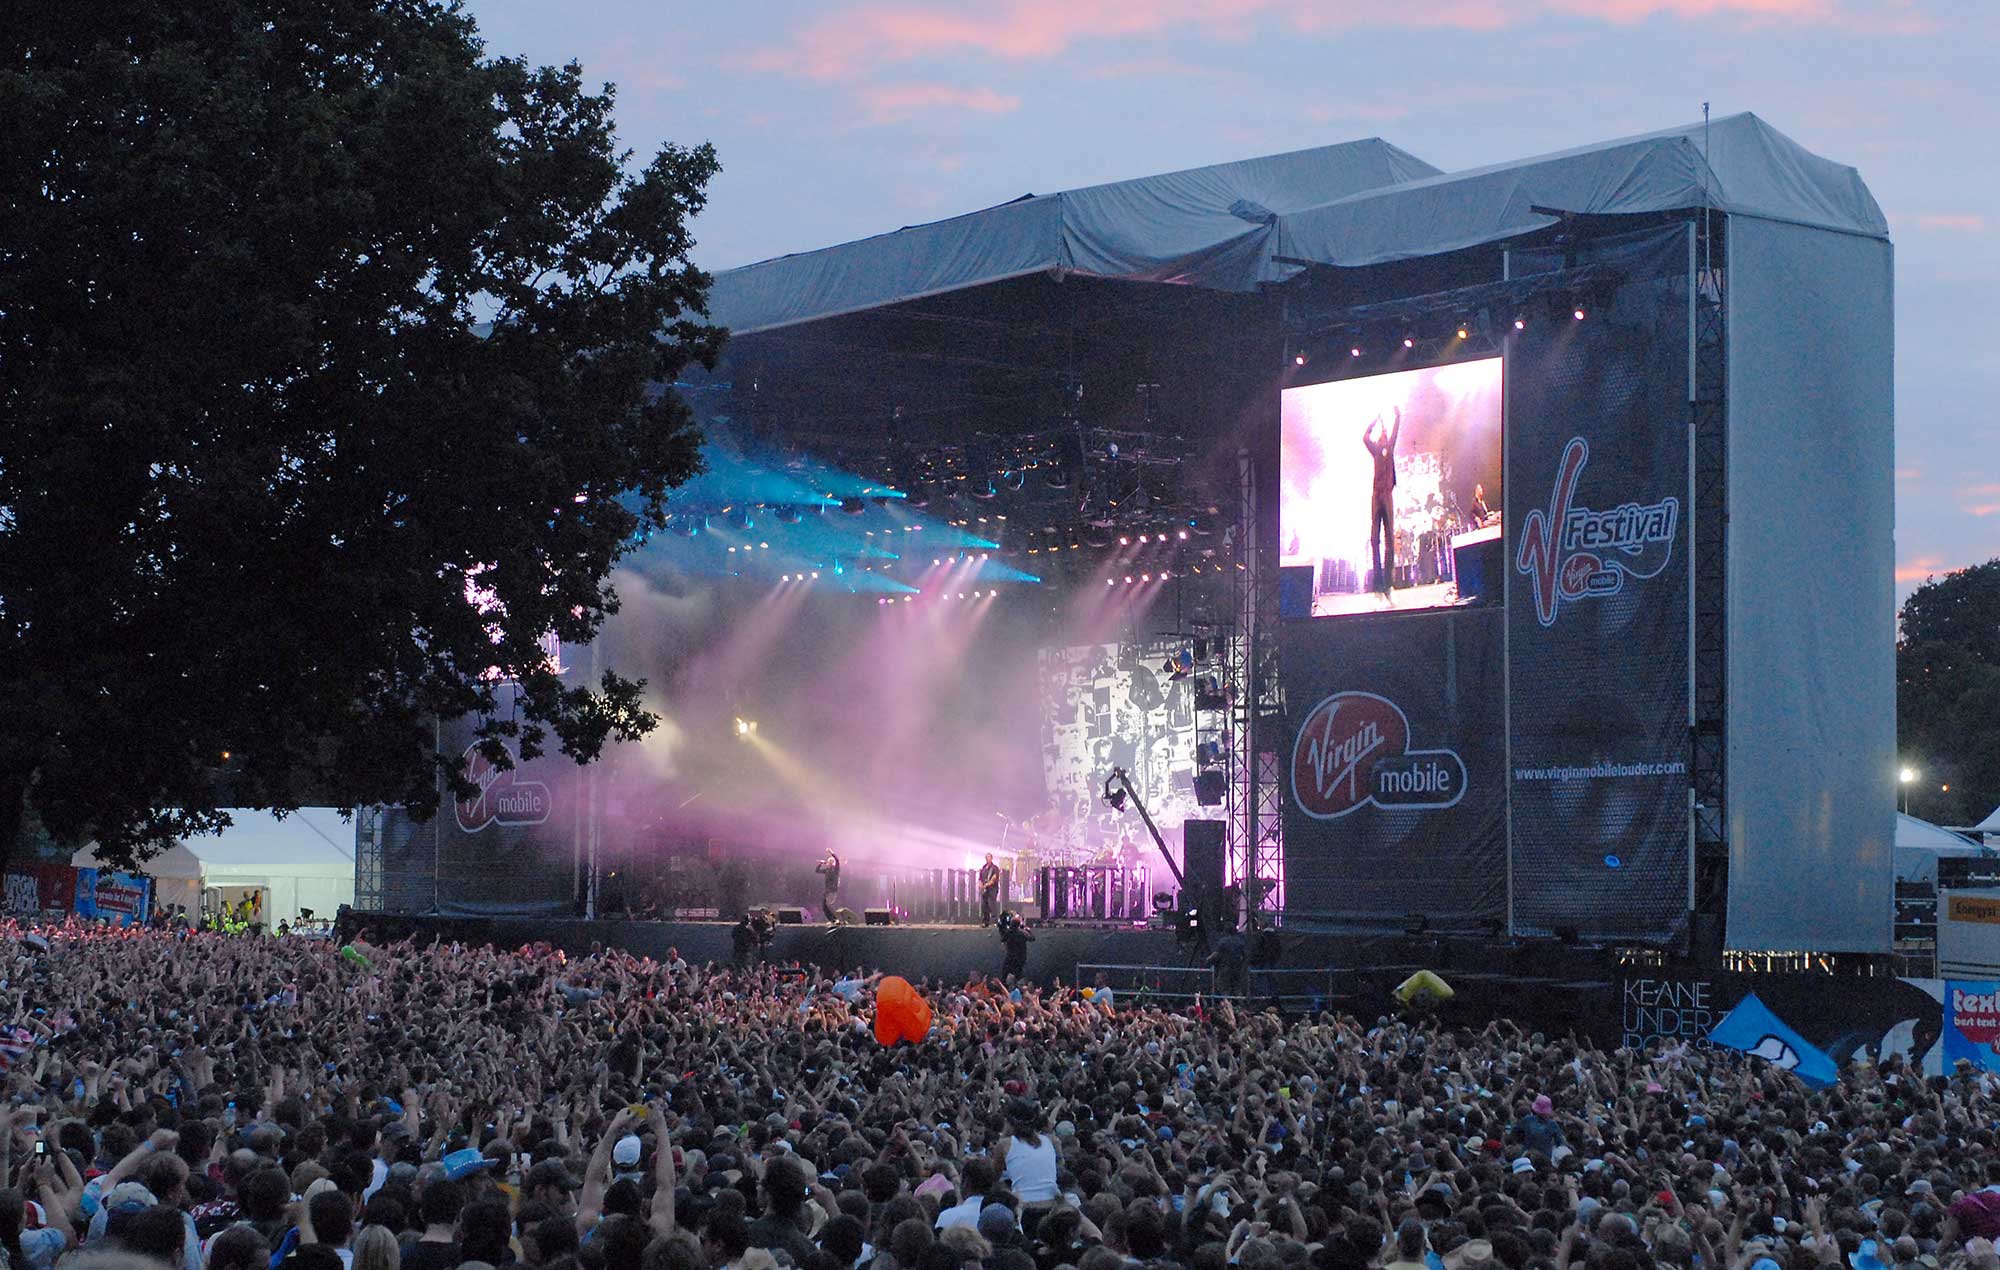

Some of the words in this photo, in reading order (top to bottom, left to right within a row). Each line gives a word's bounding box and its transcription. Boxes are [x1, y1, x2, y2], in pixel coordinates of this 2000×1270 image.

[1566, 501, 1677, 548] Festival
[1307, 702, 1384, 800] Virgin
[1380, 761, 1449, 792] mobile
[1515, 761, 1686, 782] www.virginmobilelouder.com
[499, 791, 541, 813] mobile
[1624, 979, 1711, 1009] KEANE
[1623, 1006, 1712, 1036] UNDER
